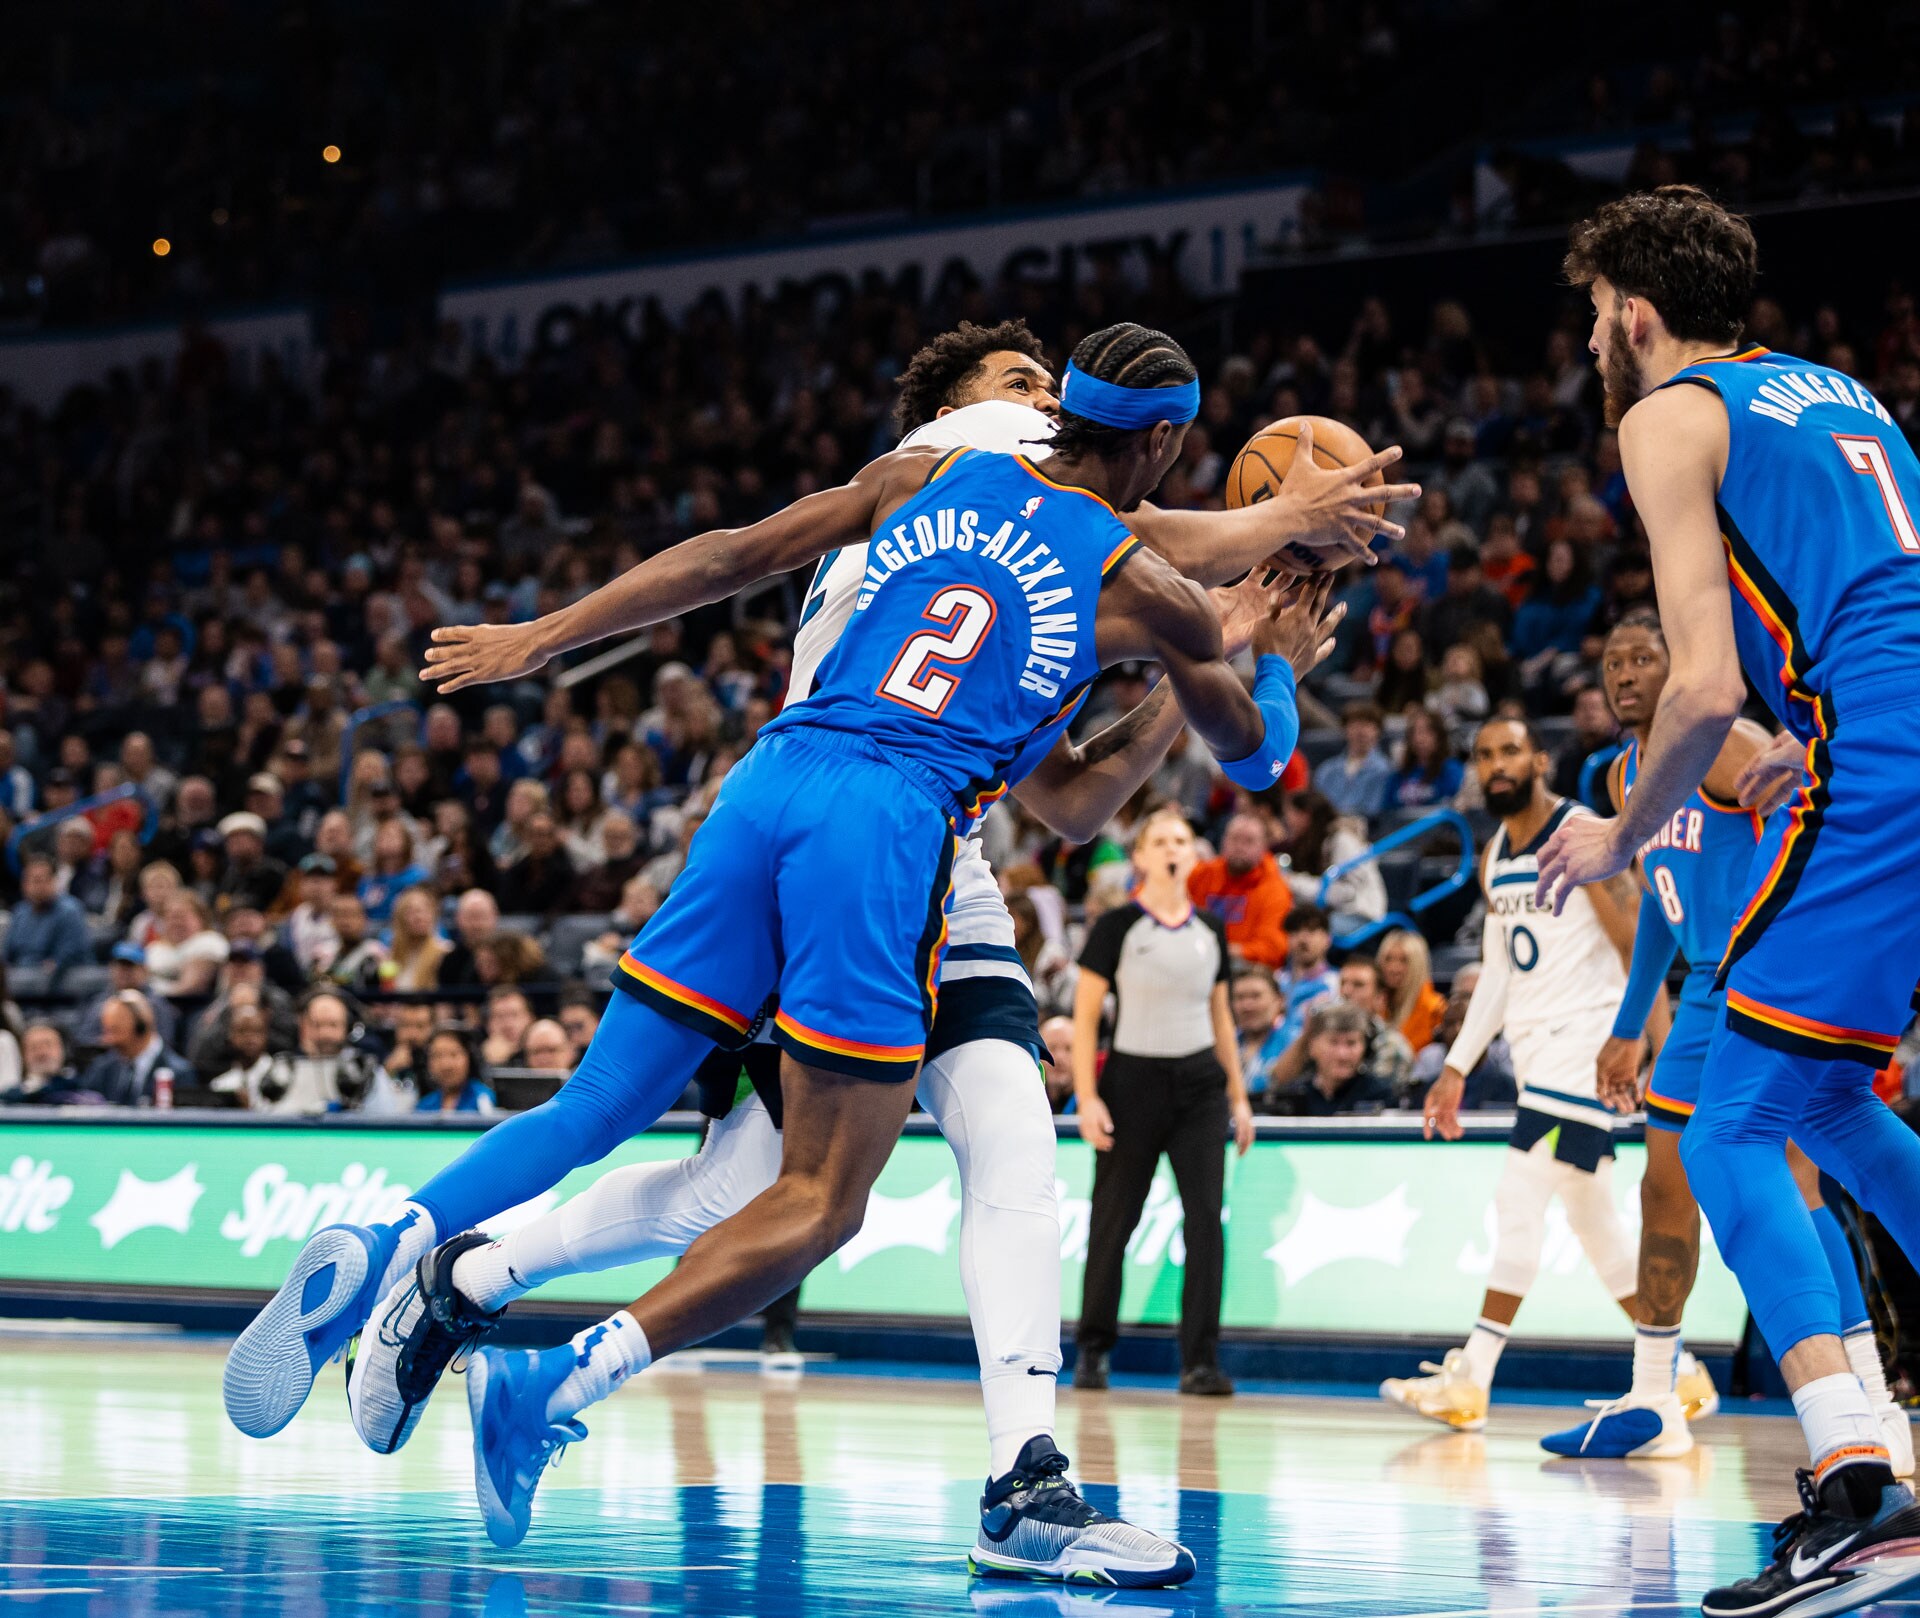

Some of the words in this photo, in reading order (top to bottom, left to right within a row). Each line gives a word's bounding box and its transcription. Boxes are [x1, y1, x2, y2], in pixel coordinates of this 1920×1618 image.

[1830, 432, 1920, 554] 7
[856, 508, 1078, 699] GILGEOUS-ALEXANDER
[874, 583, 998, 720] 2
[1495, 892, 1554, 915] OLVES
[1653, 864, 1684, 925] 8
[0, 1155, 74, 1233] ite
